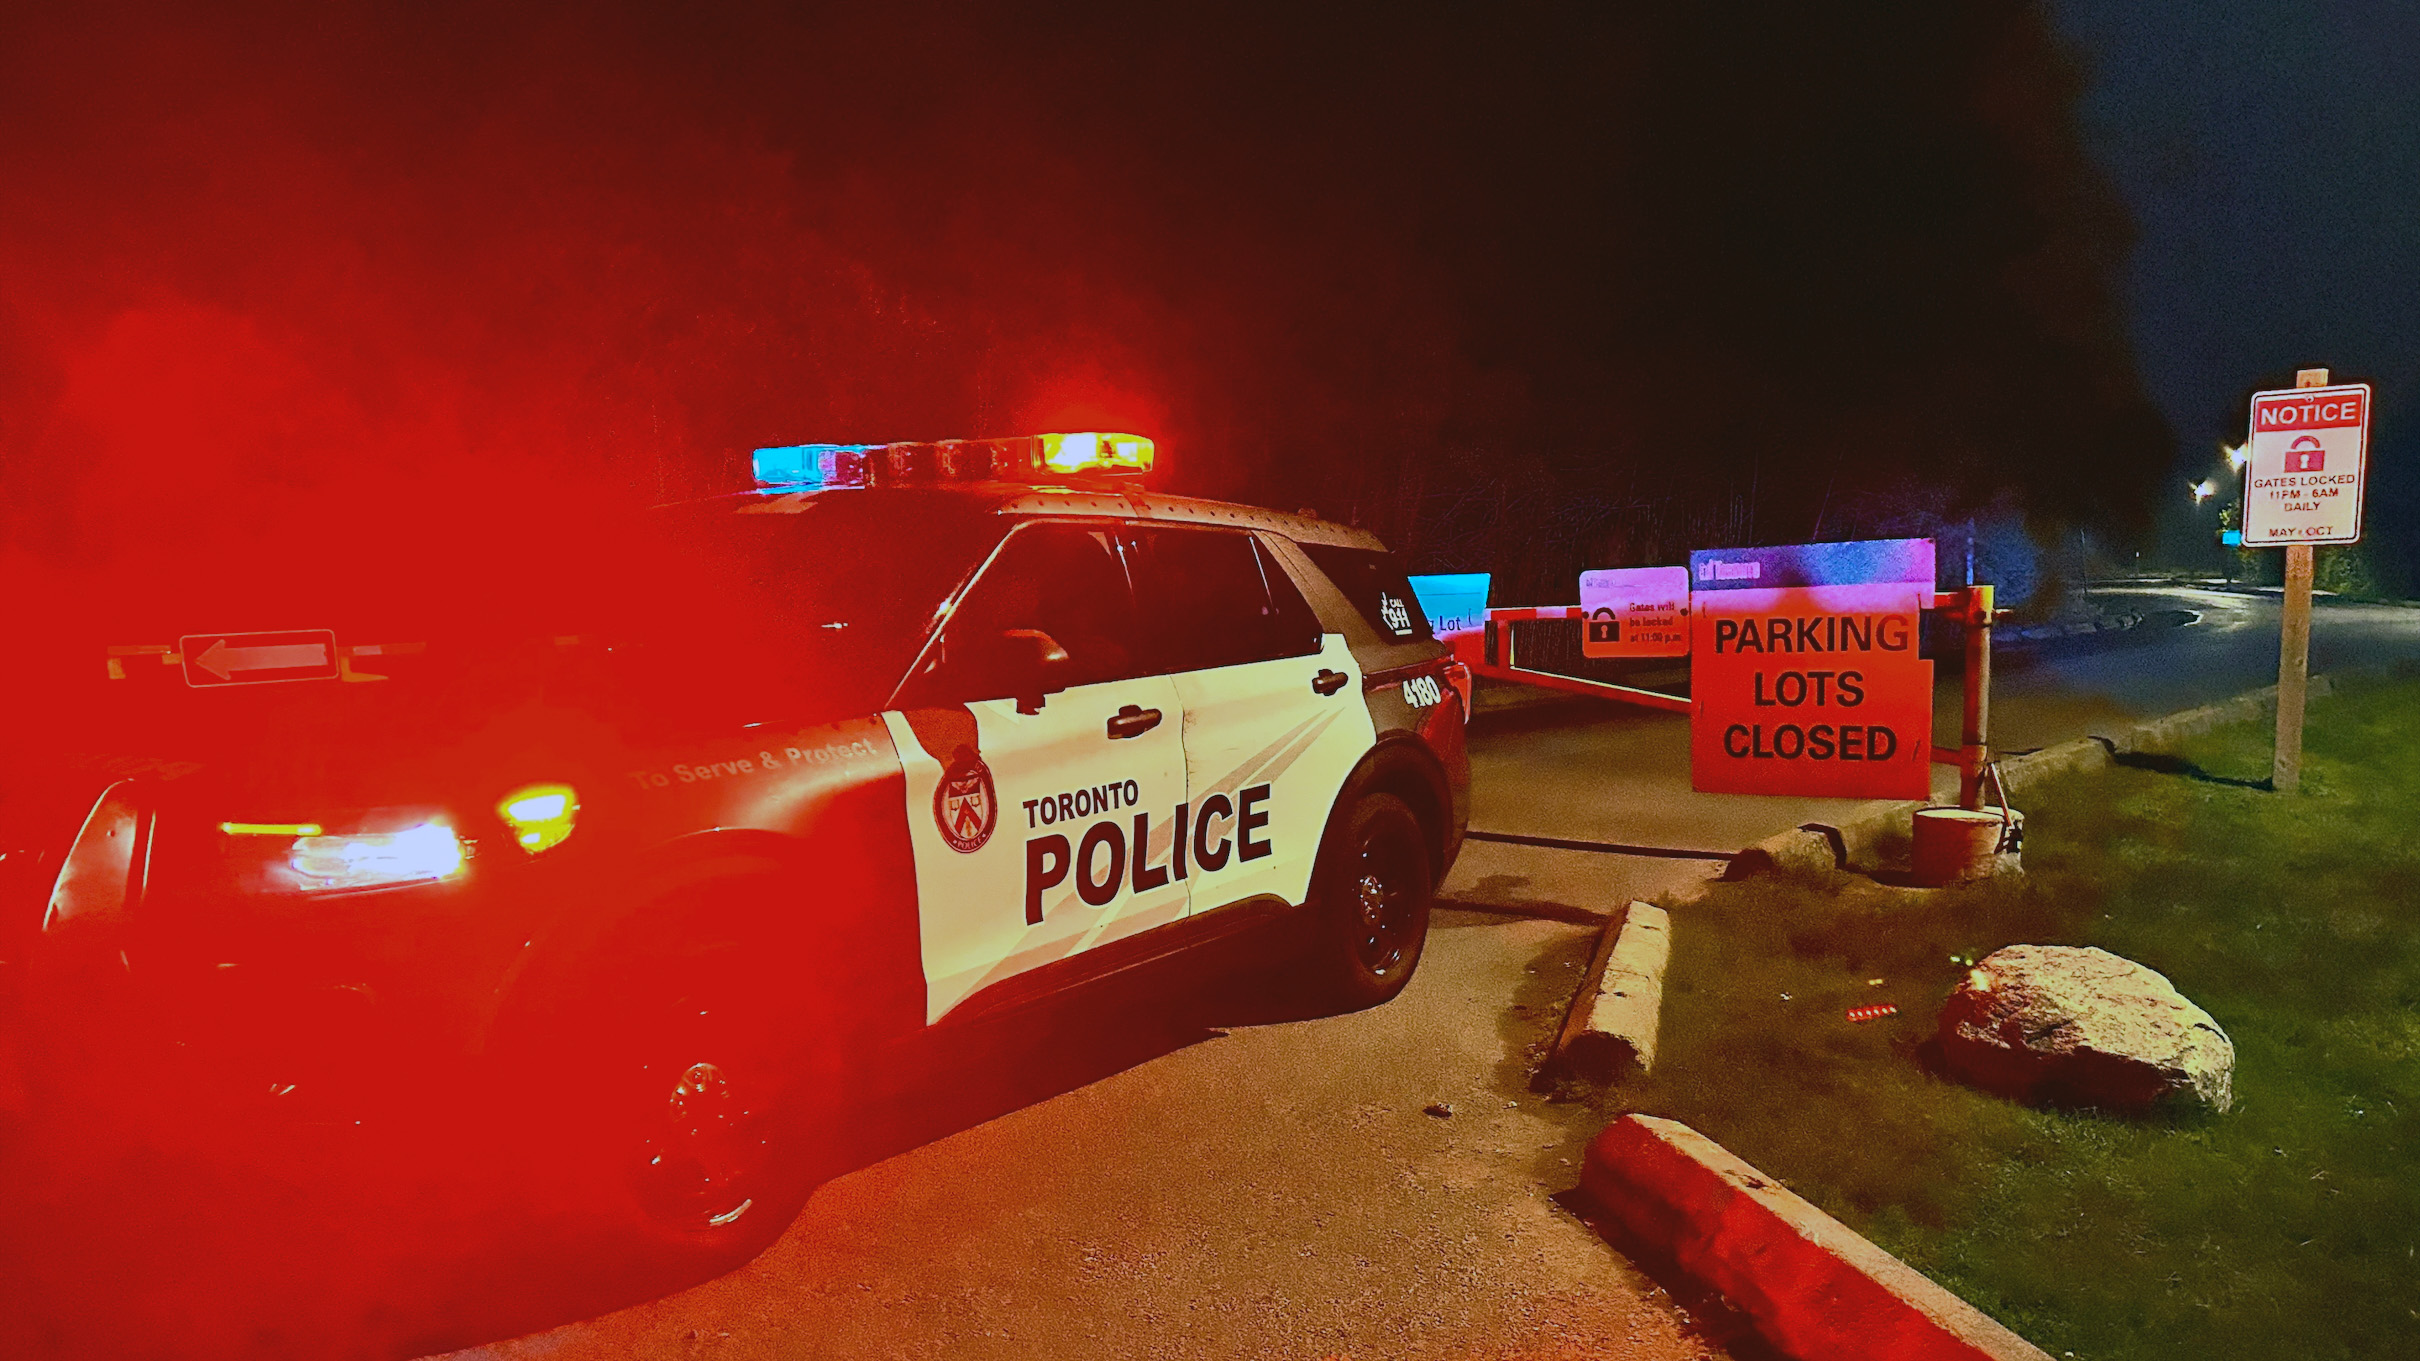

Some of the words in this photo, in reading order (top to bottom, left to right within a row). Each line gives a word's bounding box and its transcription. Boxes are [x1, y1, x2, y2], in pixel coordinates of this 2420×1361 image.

[2261, 402, 2357, 425] NOTICE
[2254, 476, 2297, 489] GATES
[2300, 474, 2355, 486] LOCKED
[2269, 489, 2301, 500] 11PM
[2311, 487, 2339, 498] 6AM
[2284, 502, 2321, 512] DAILY
[2268, 527, 2296, 538] MAY
[2305, 526, 2334, 537] OCT
[1629, 602, 1655, 612] Gates
[1657, 601, 1675, 611] will
[1388, 607, 1411, 629] 911
[1440, 615, 1462, 631] Lot
[1629, 617, 1641, 626] be
[1643, 616, 1673, 626] locked
[1715, 614, 1909, 654] PARKING
[1402, 675, 1442, 708] 4180
[1754, 670, 1865, 707] LOTS
[1723, 723, 1898, 761] CLOSED
[629, 770, 670, 790] To
[673, 758, 755, 784] Serve
[759, 750, 783, 770] &
[785, 738, 878, 765] Protect
[1022, 779, 1139, 828] TORONTO
[1025, 783, 1273, 926] POLICE
